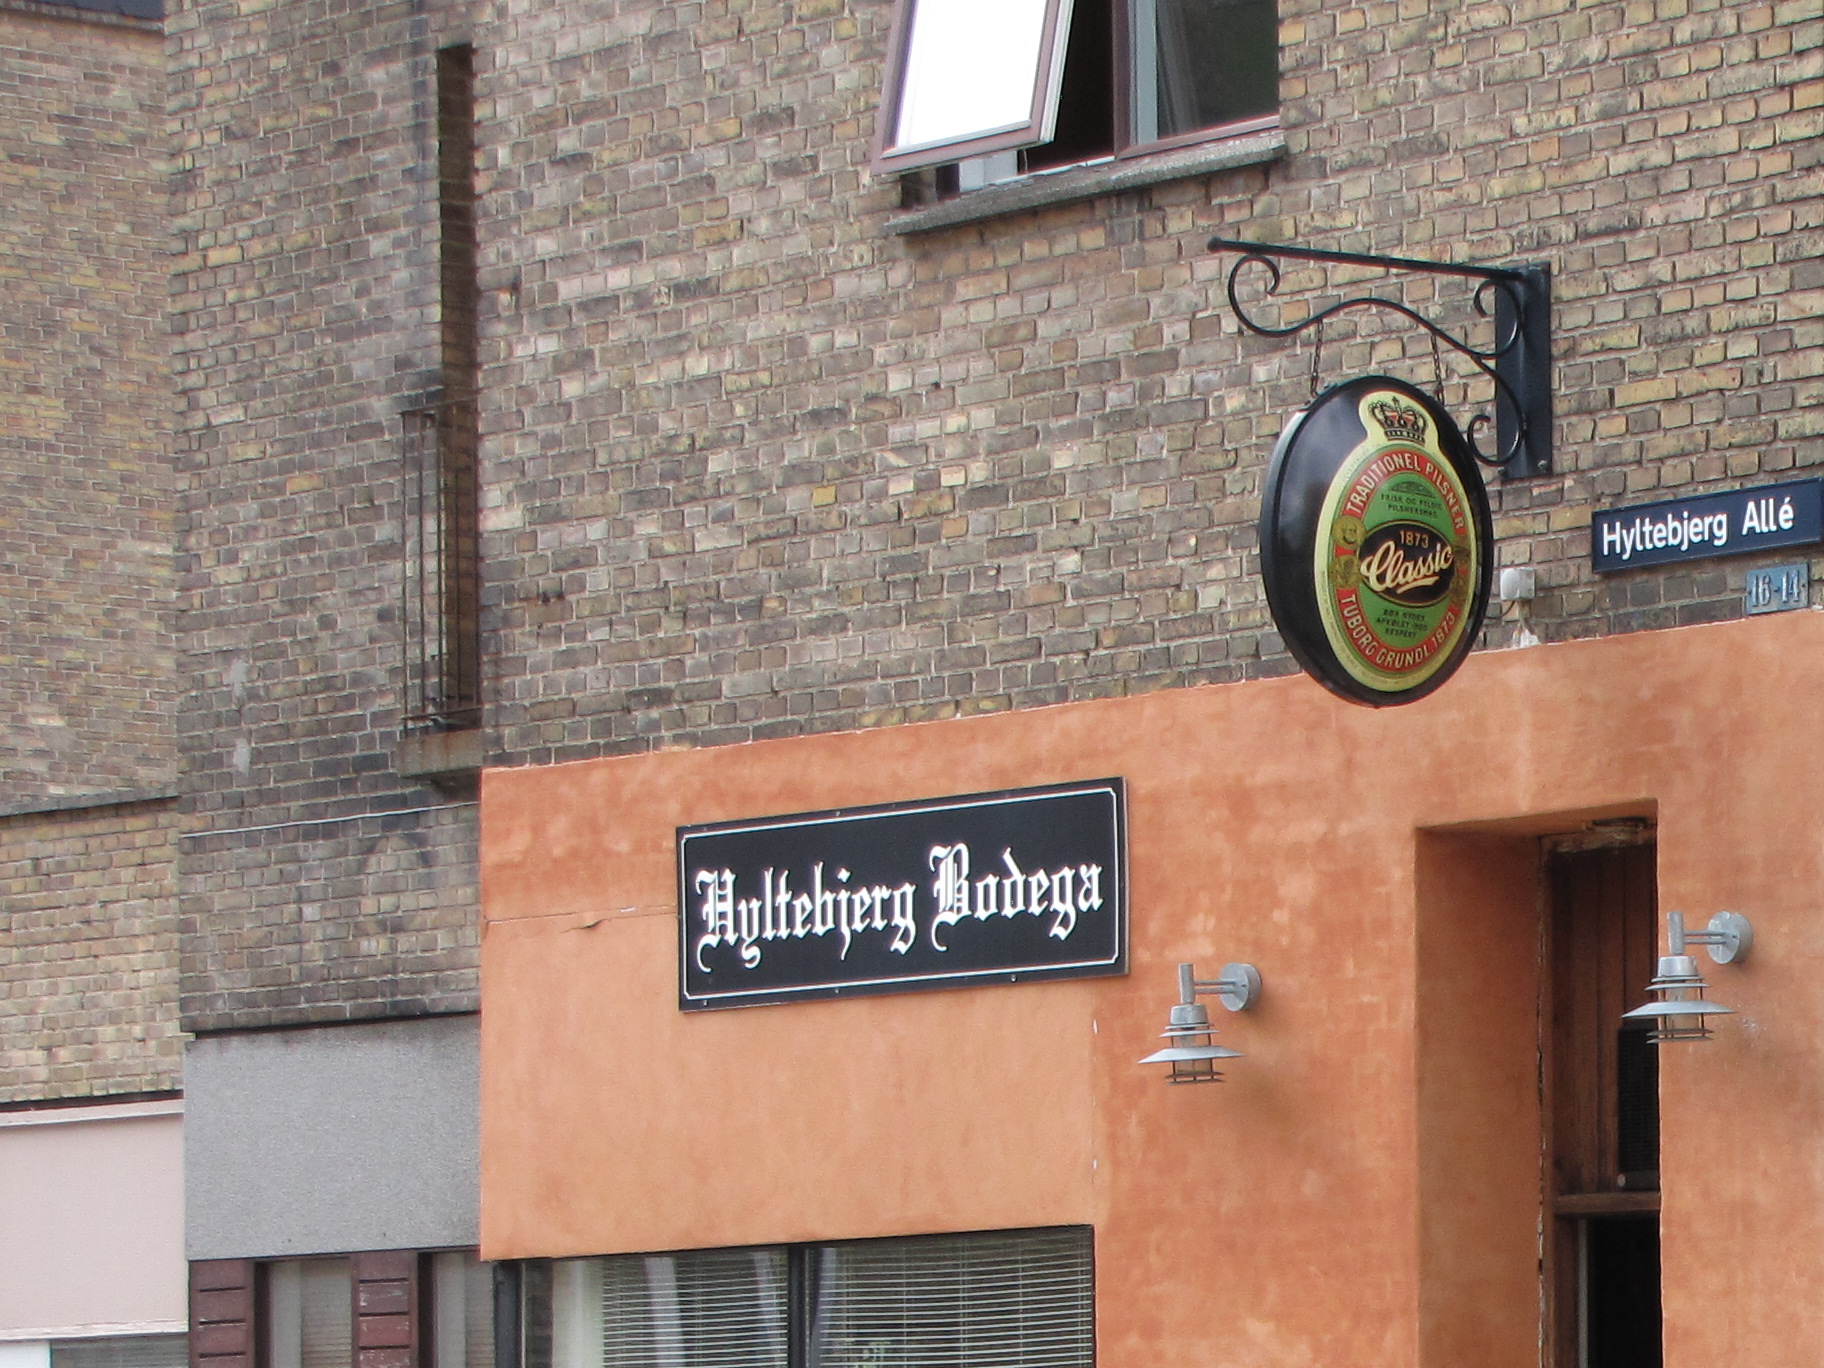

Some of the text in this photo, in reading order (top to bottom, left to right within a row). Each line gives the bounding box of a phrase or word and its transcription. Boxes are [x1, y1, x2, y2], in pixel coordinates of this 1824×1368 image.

[1346, 453, 1422, 514] TRADITIONEL
[1425, 462, 1464, 529] PILSNER
[1400, 530, 1429, 548] 1873
[1602, 496, 1794, 560] Hyltebjerg Allé
[1360, 541, 1453, 592] Classic
[1341, 594, 1379, 656] TUBORG
[1431, 611, 1456, 647] 1873
[695, 842, 1104, 973] Hyltebjerg Bodega
